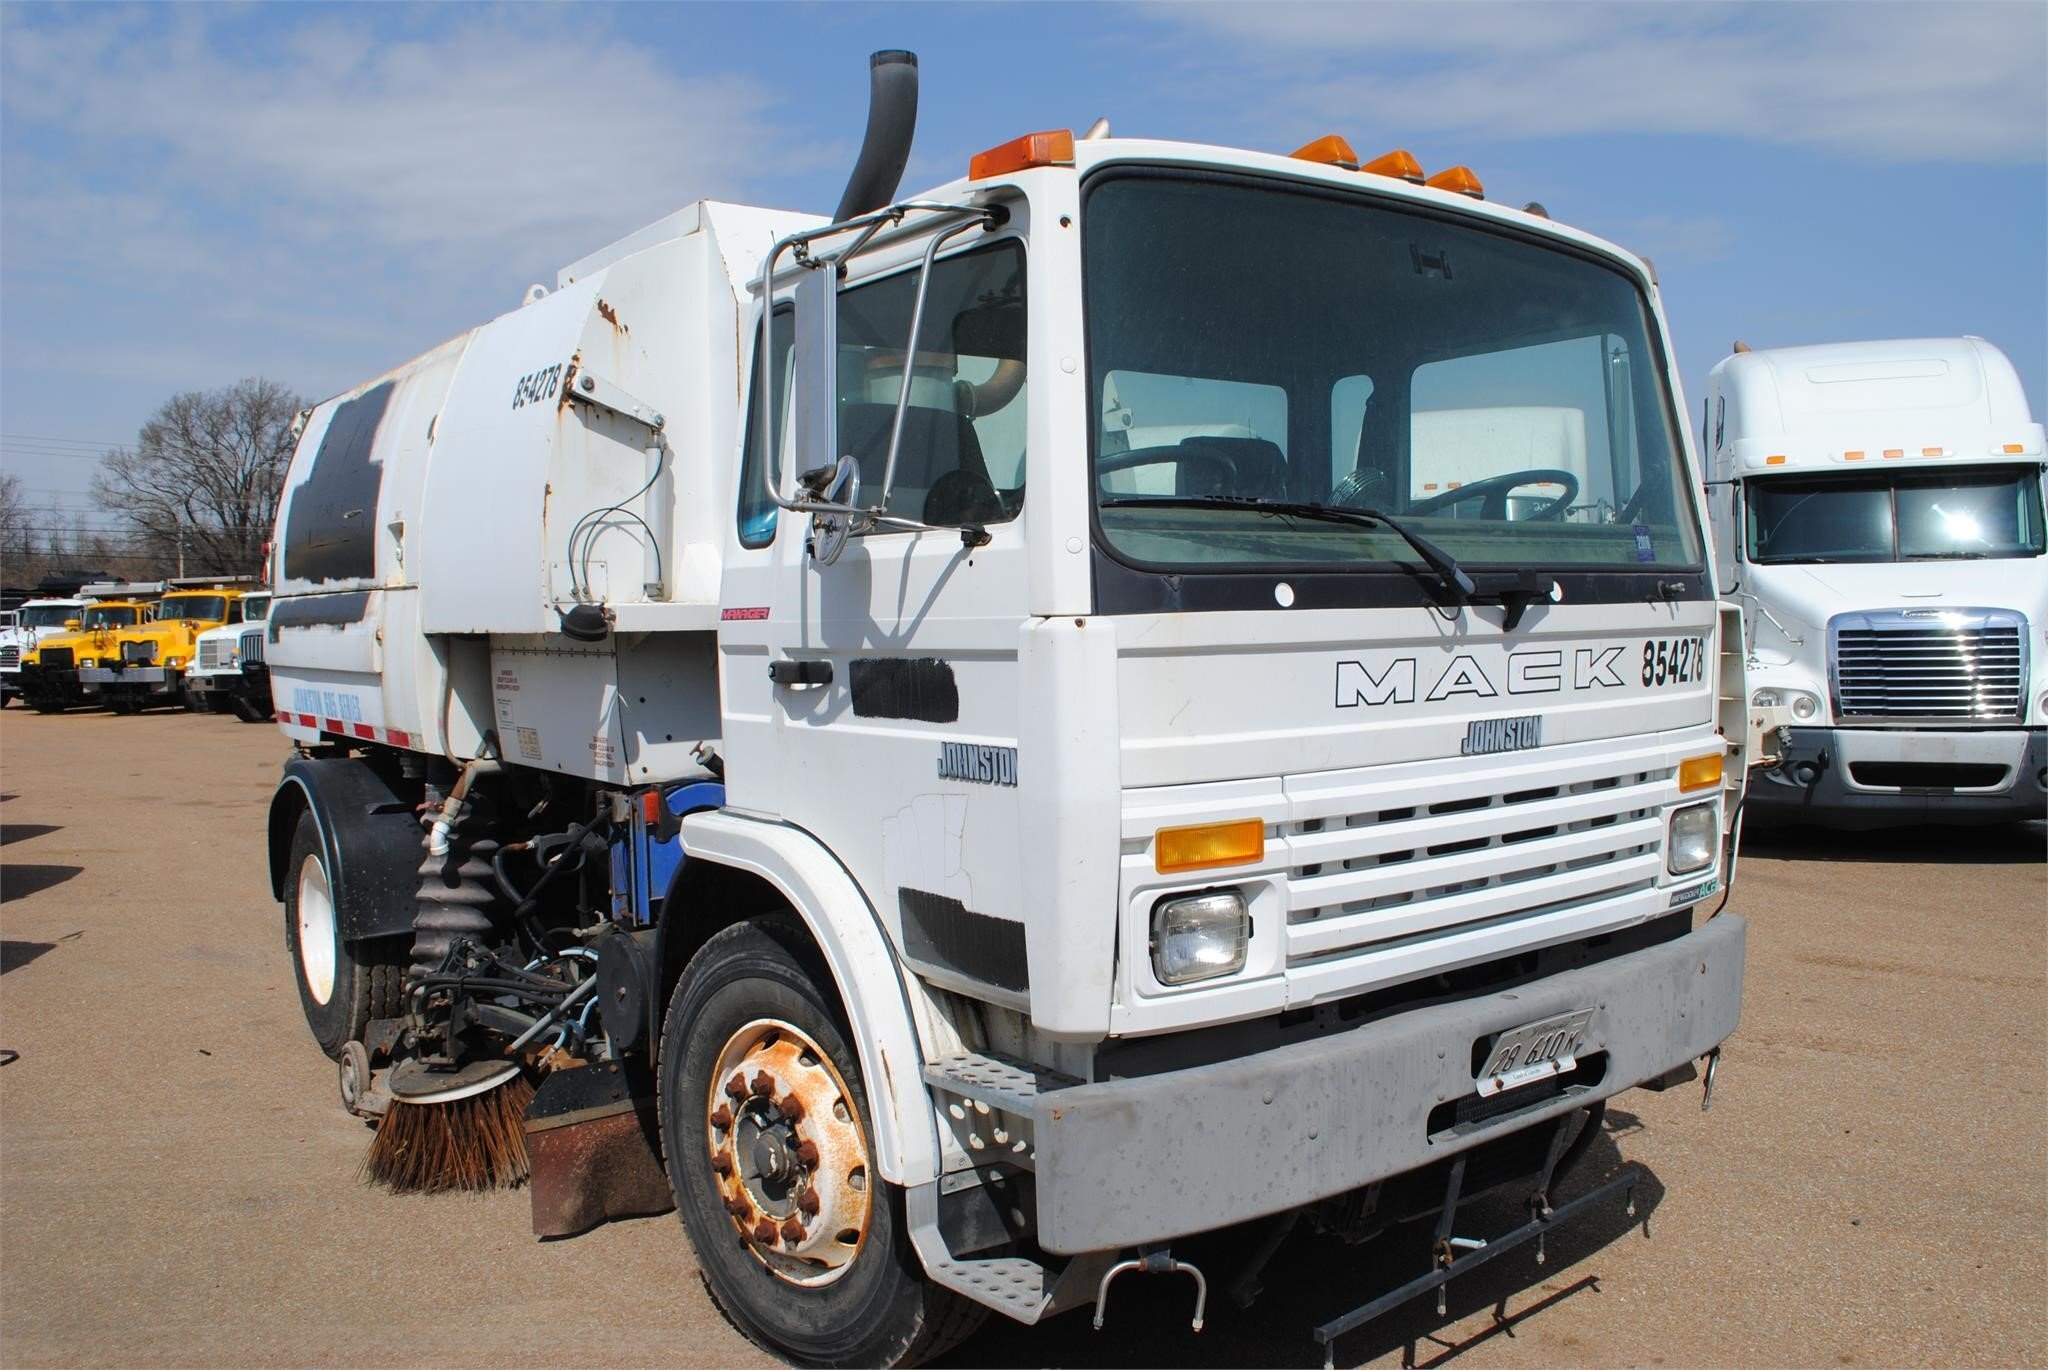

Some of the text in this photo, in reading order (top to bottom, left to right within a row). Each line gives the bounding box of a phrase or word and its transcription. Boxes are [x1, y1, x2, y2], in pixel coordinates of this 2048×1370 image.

[512, 362, 562, 410] 854278
[1335, 646, 1626, 708] MACK
[1641, 637, 1704, 688] 854278
[1461, 714, 1543, 756] JOHNSTON
[937, 741, 1018, 788] JOHNSTON
[1488, 1043, 1522, 1078] 28
[1525, 1030, 1566, 1066] 610
